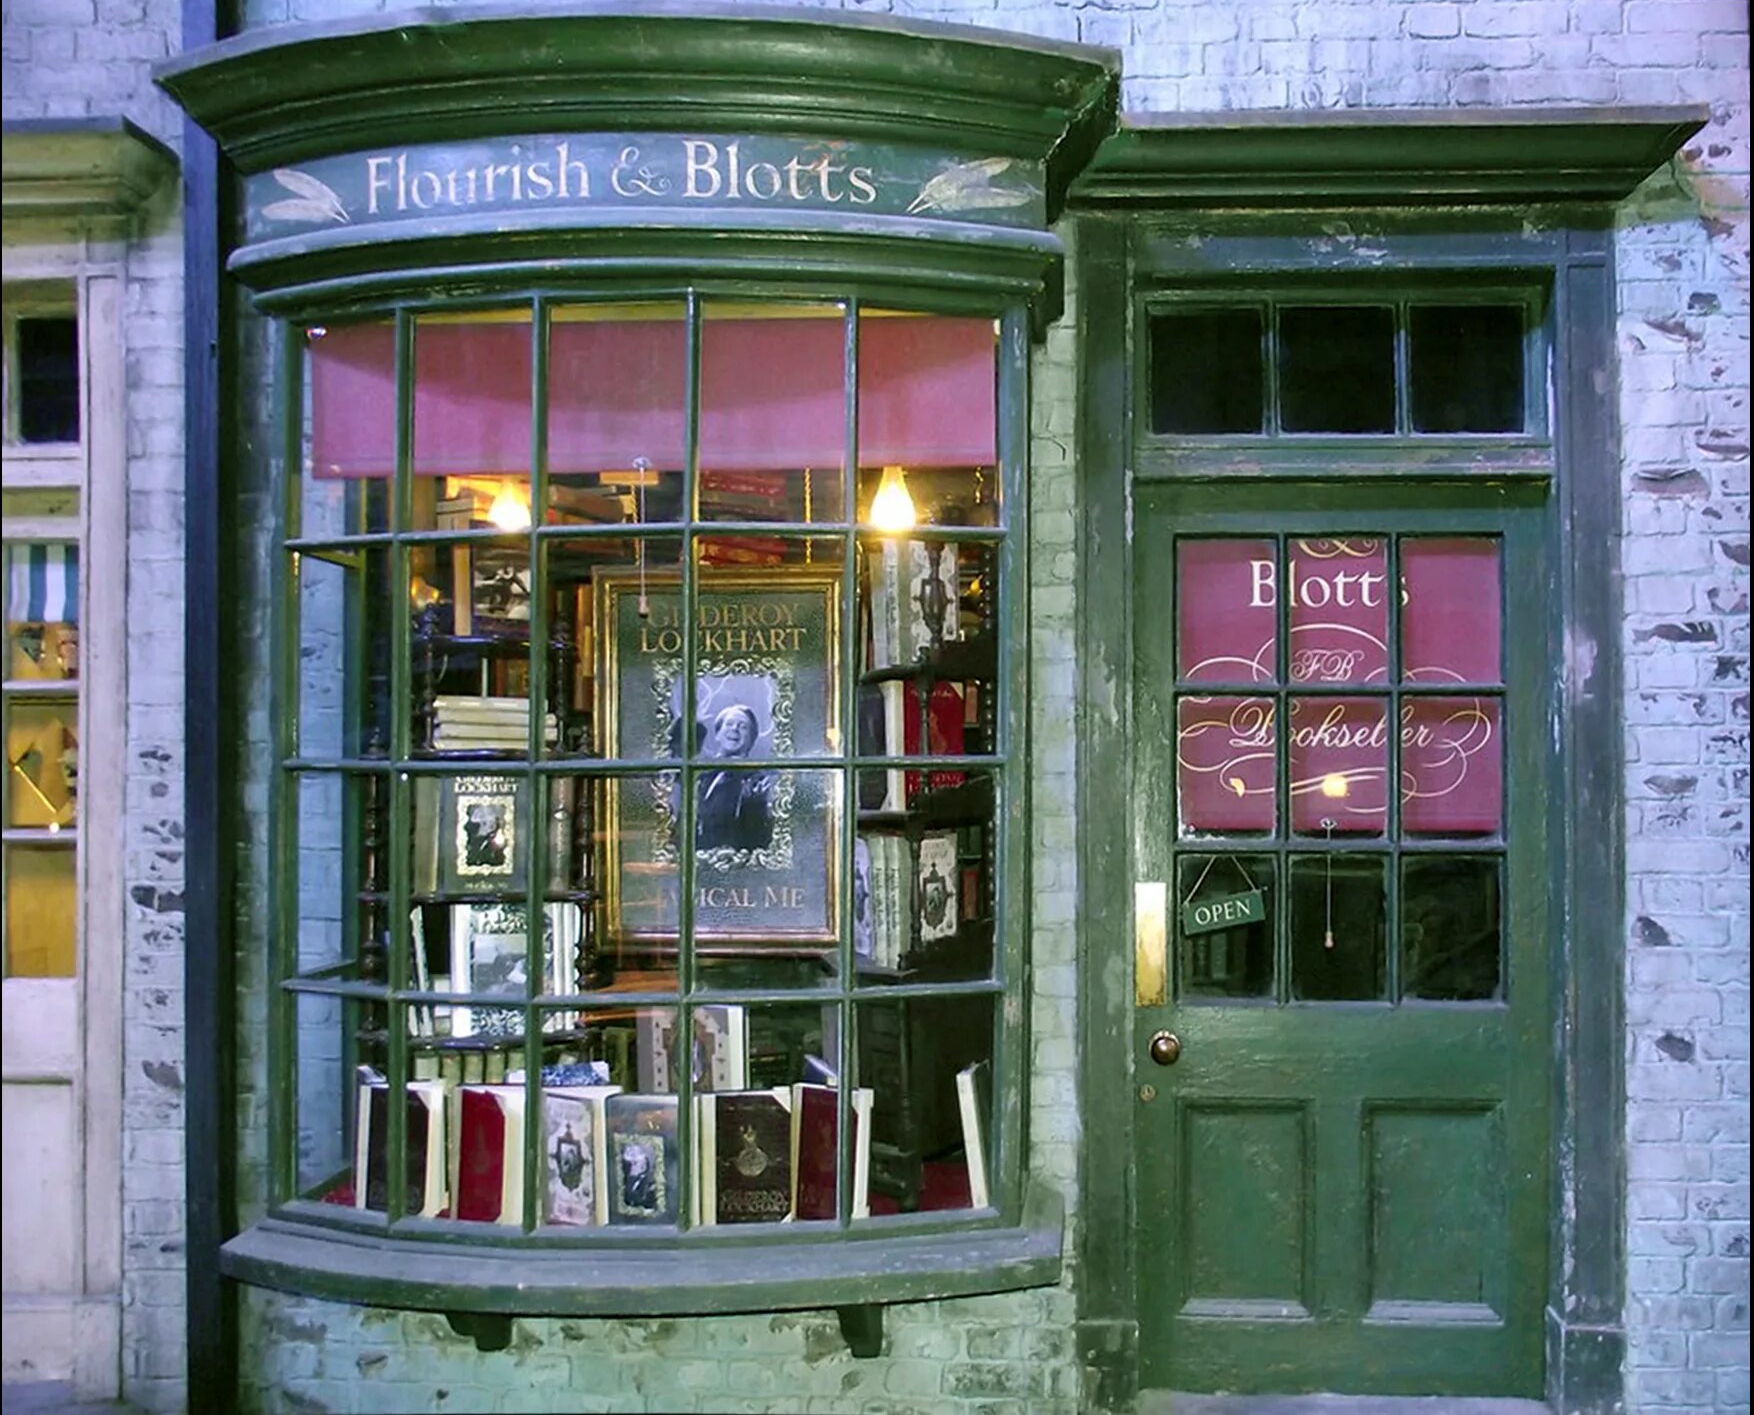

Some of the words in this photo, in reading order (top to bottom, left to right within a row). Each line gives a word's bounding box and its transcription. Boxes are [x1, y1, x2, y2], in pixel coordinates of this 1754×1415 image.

[366, 141, 591, 214] Flourish
[611, 147, 670, 197] &
[682, 139, 878, 205] Blotts
[648, 603, 798, 628] GIDEROY
[640, 628, 807, 653] LOKHART
[1195, 898, 1251, 925] OPEN
